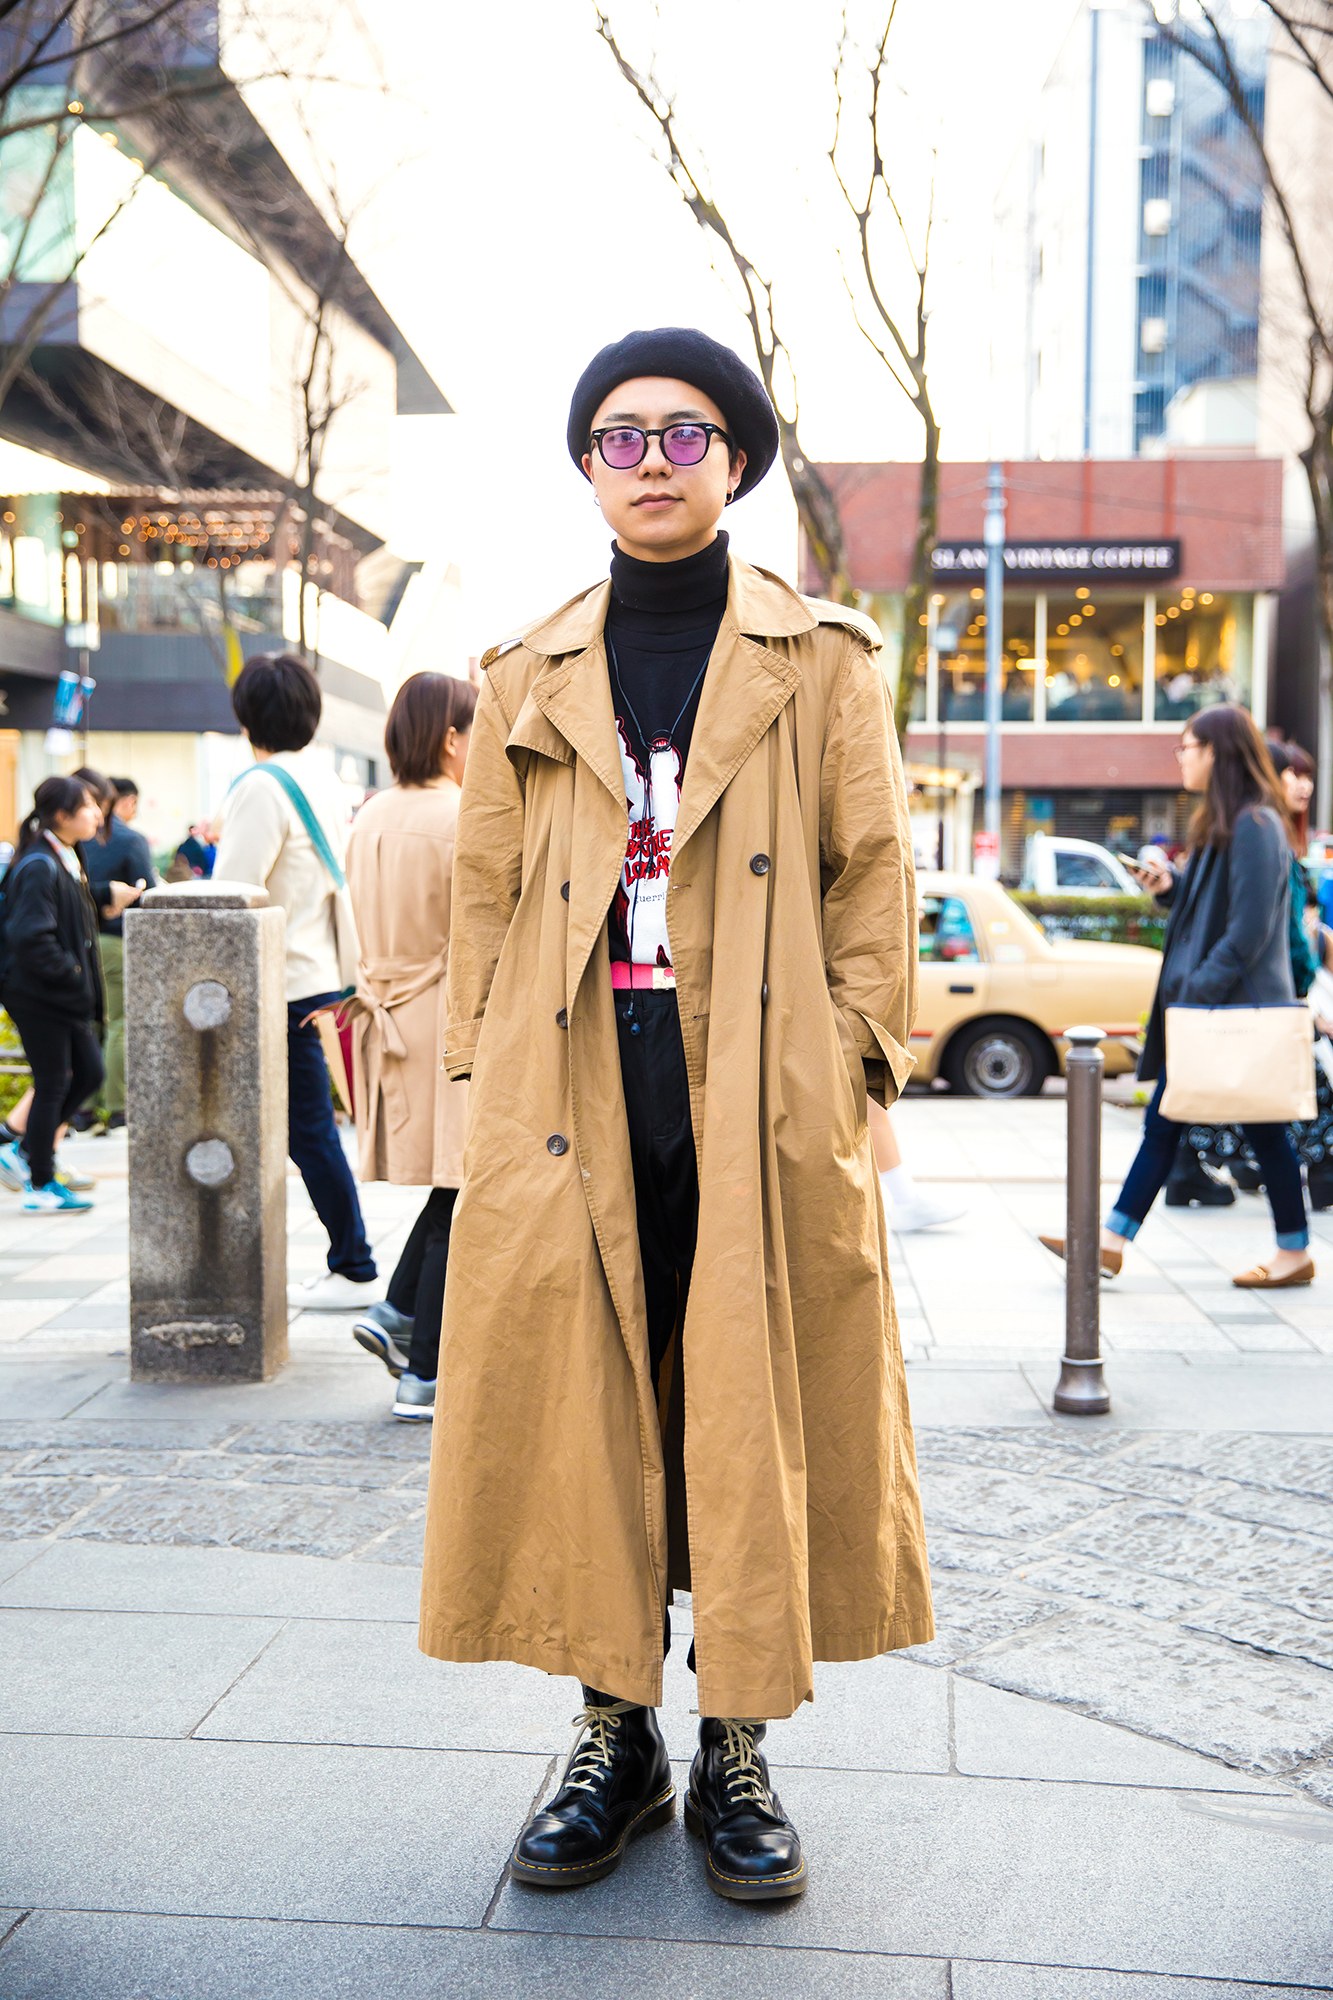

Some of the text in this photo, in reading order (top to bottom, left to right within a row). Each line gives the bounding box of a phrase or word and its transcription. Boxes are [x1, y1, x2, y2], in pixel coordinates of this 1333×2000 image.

[1003, 547, 1092, 569] VINTAGE
[1092, 547, 1174, 568] COFFEE
[629, 816, 655, 841] THE
[625, 829, 674, 860] BATTLE
